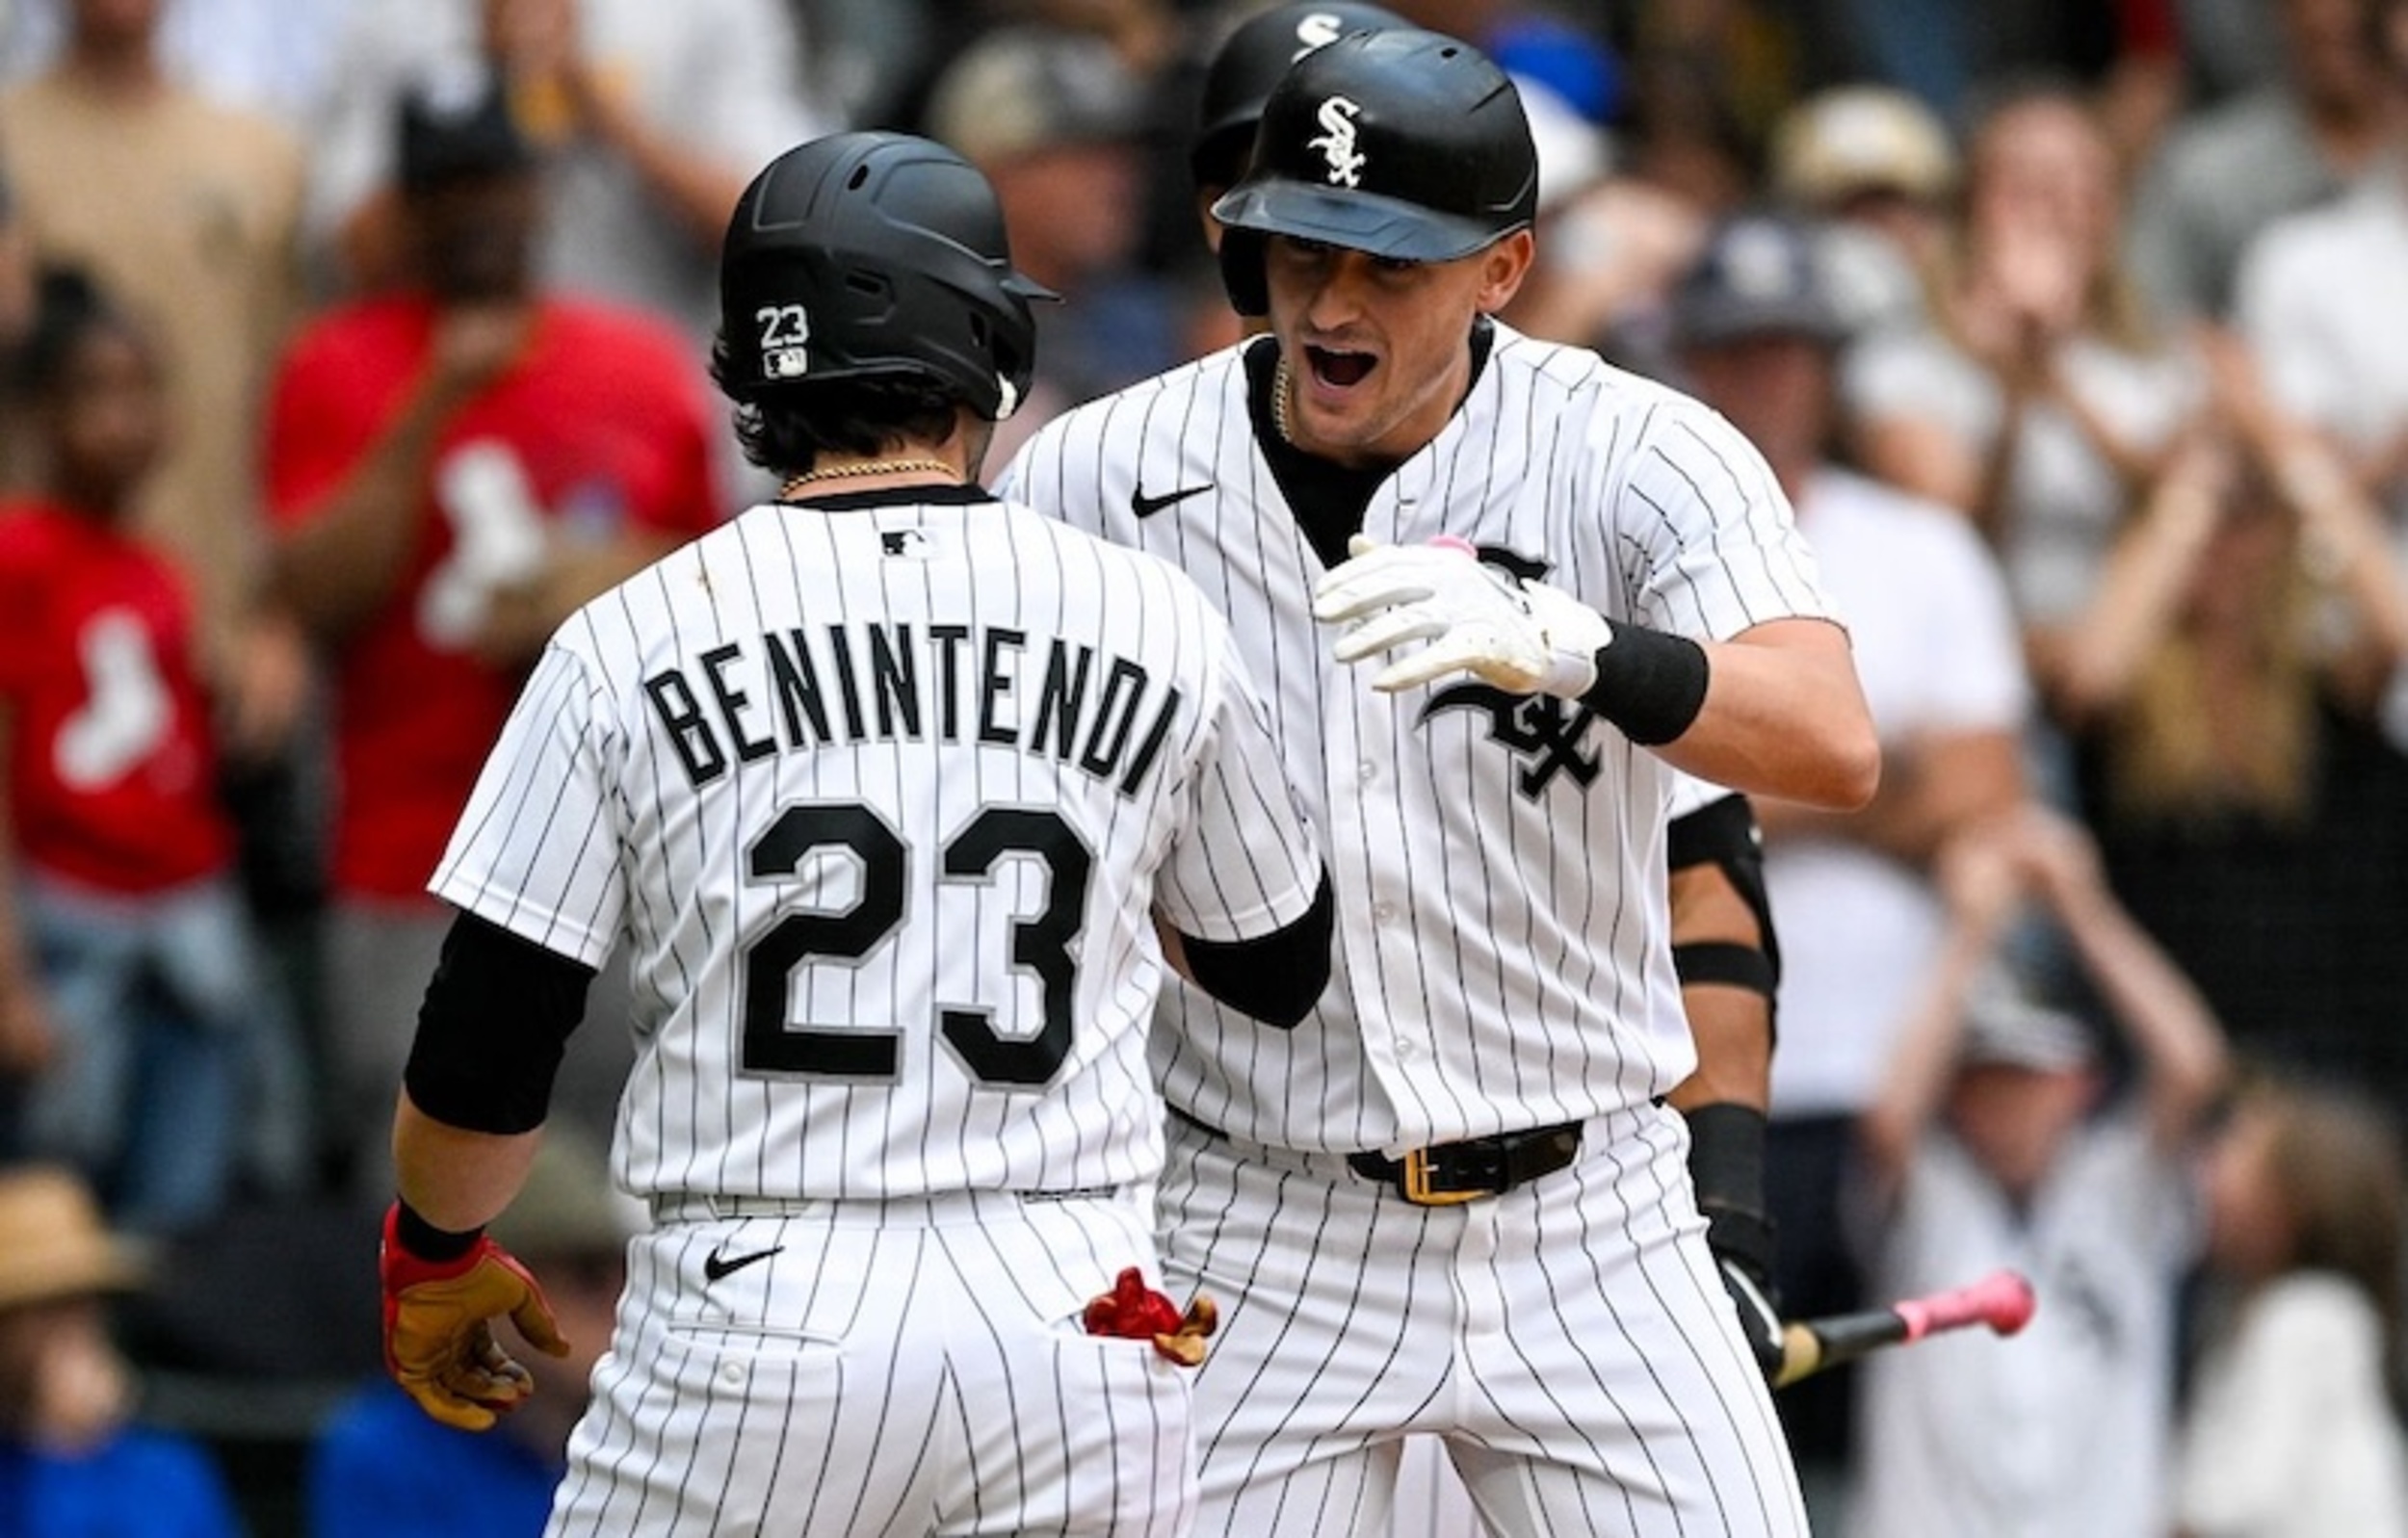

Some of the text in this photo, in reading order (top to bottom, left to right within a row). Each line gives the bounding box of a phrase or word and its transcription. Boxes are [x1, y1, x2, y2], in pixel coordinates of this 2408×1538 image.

[756, 304, 809, 349] 23
[643, 621, 1181, 801] BENINTENDI
[736, 797, 1098, 1093] 23
